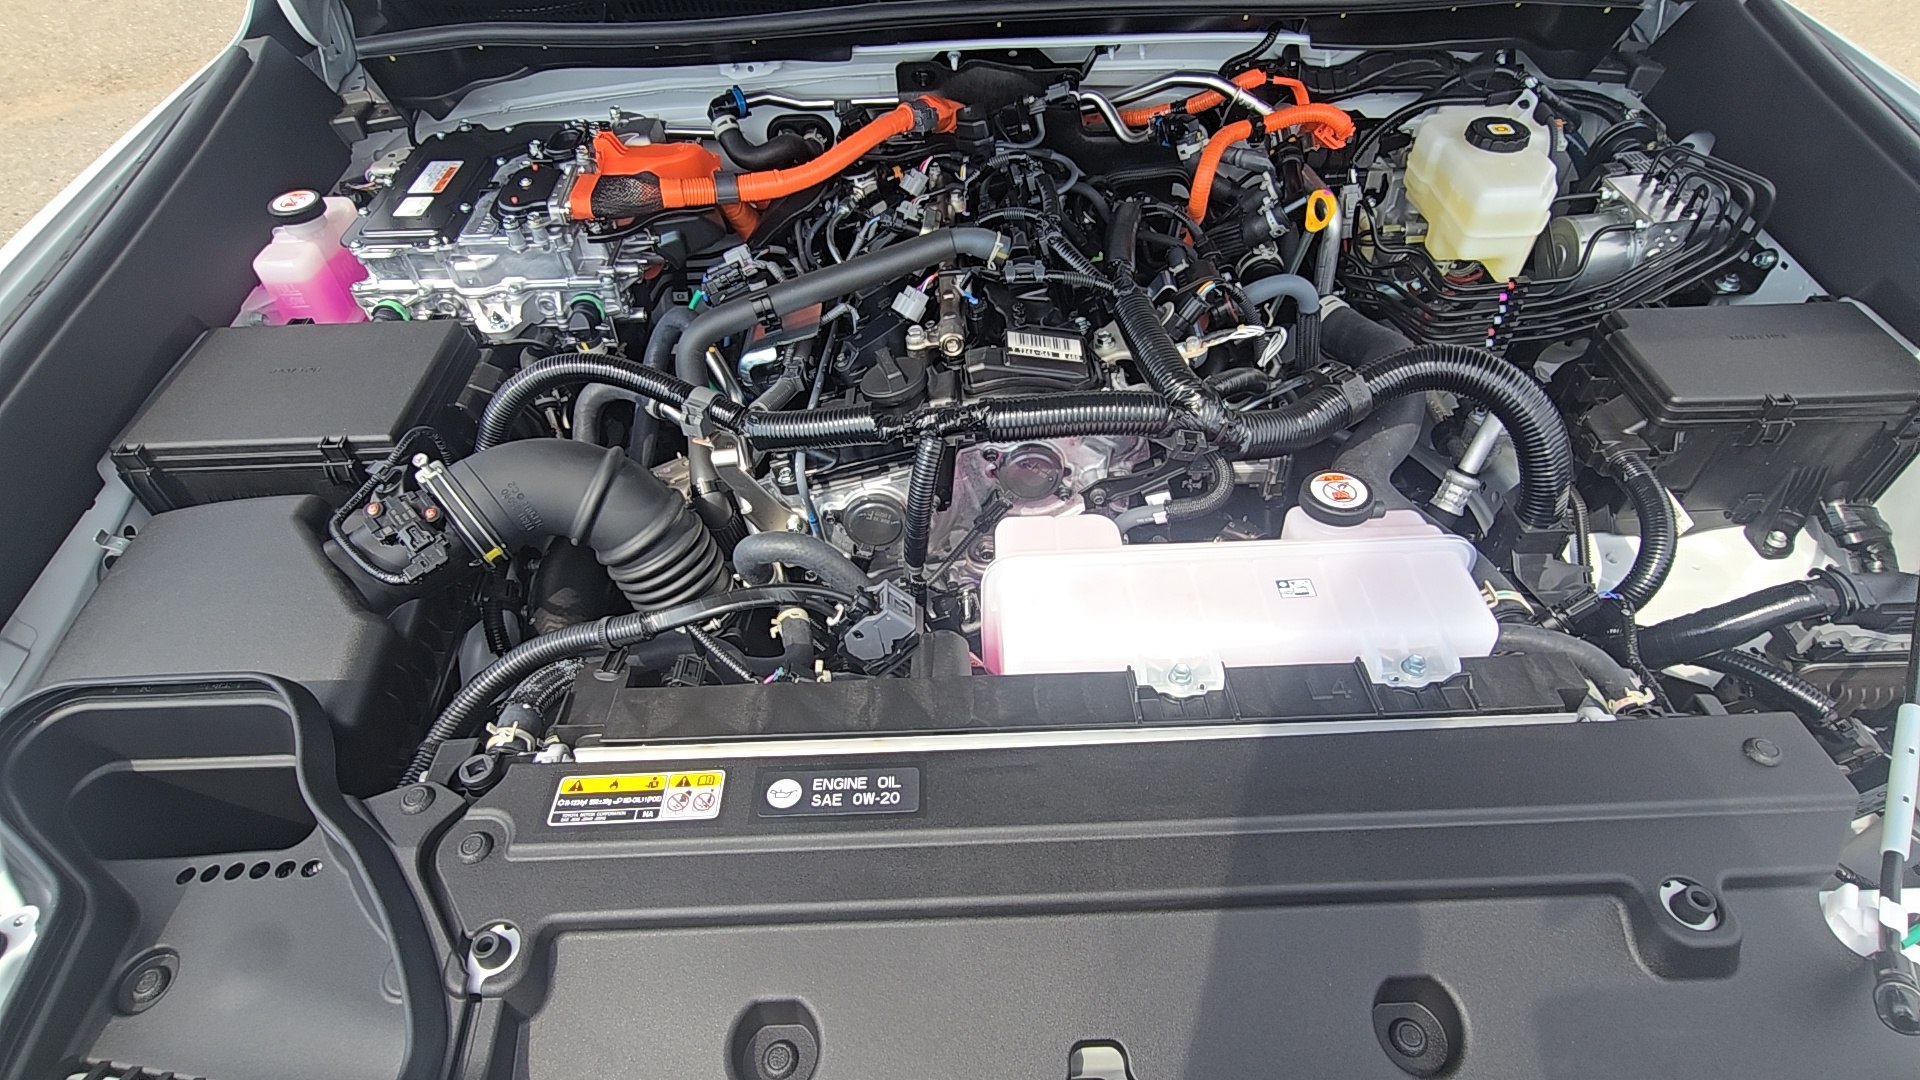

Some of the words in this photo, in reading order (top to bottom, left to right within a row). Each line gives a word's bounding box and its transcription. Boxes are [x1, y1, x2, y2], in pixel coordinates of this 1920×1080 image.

[812, 776, 868, 791] ENGINE
[877, 775, 902, 789] OIL
[811, 793, 843, 807] SAE
[852, 791, 901, 806] 0W-20
